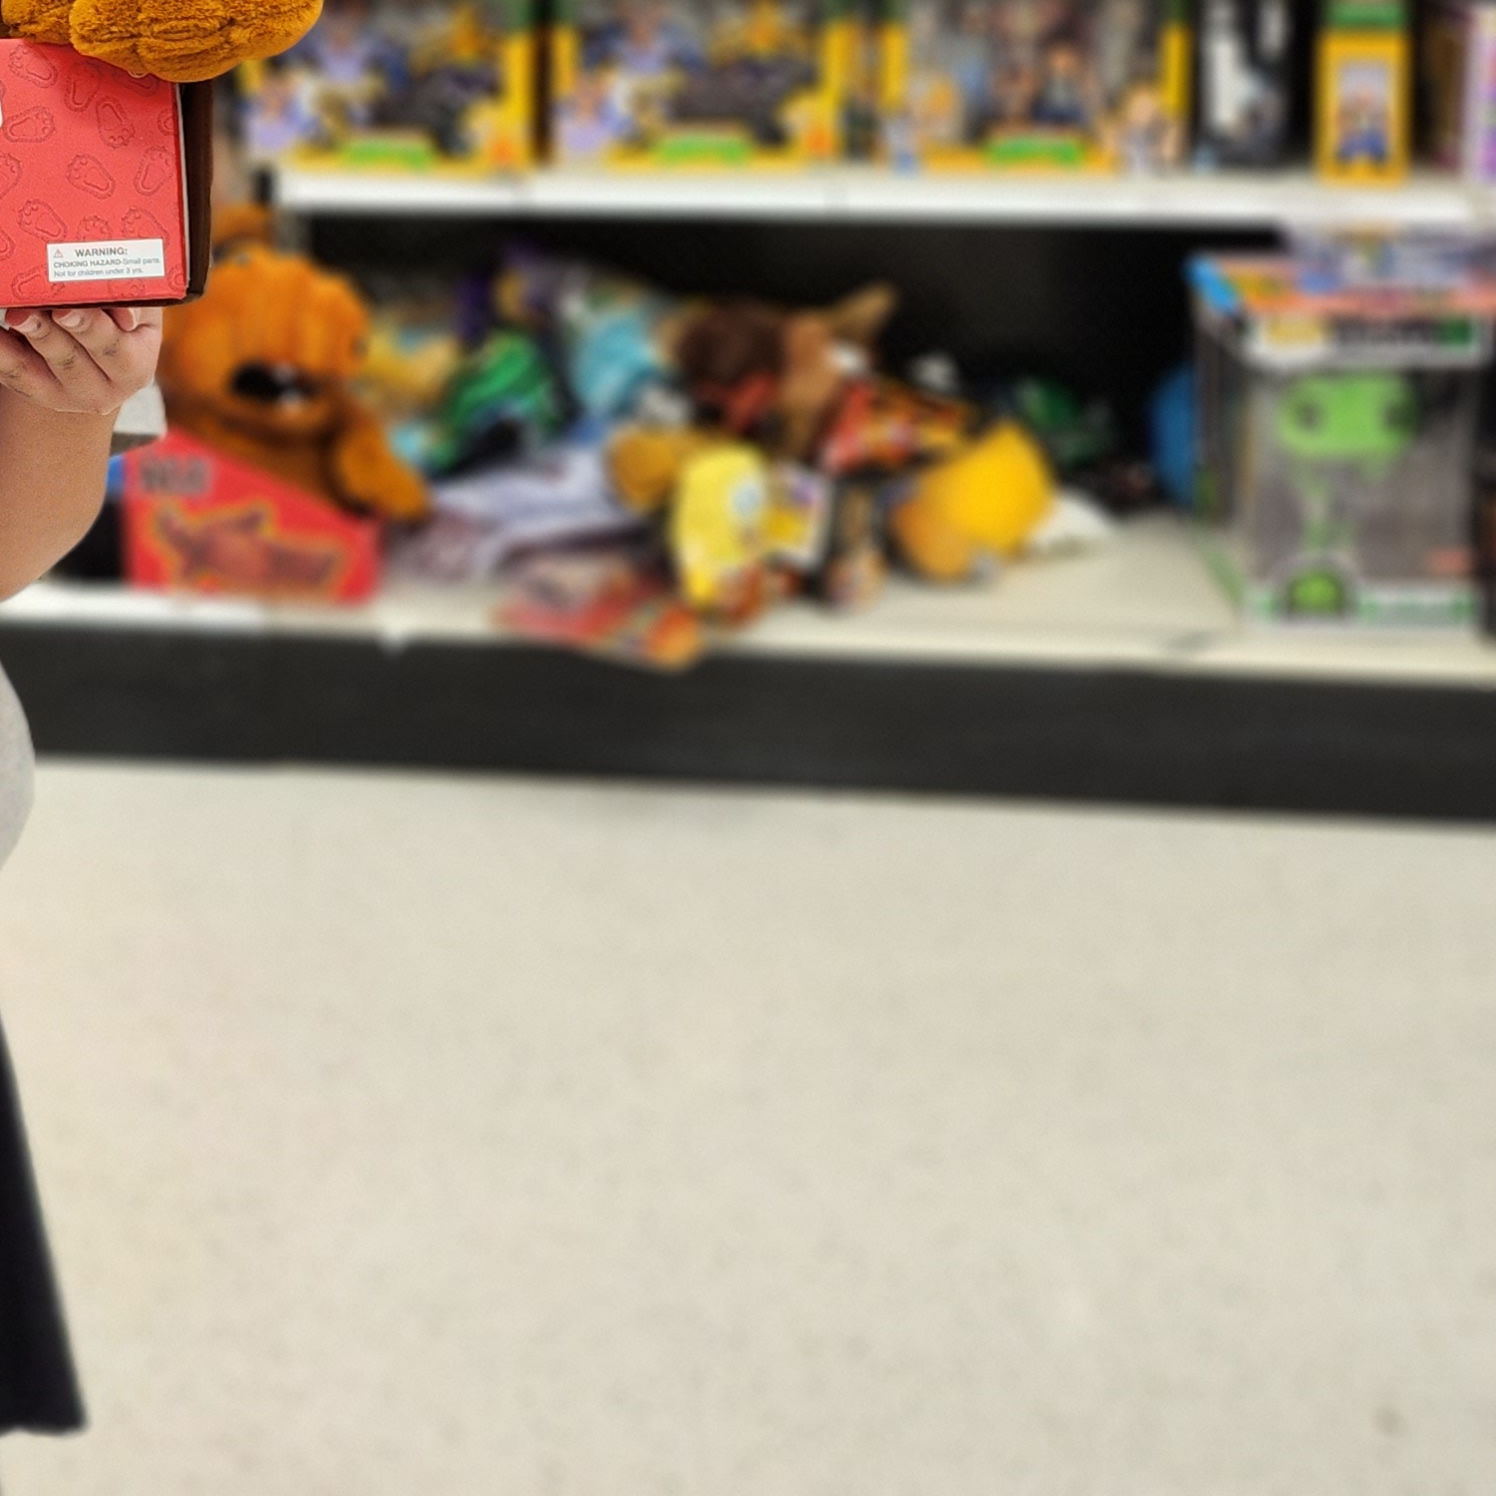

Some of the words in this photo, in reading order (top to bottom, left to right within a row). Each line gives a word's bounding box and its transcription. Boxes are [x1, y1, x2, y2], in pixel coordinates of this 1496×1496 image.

[74, 246, 128, 258] WARNING:
[53, 260, 89, 269] CHOKING
[53, 270, 66, 278] Not
[67, 269, 77, 278] for
[77, 268, 104, 277] children
[105, 267, 124, 276] under
